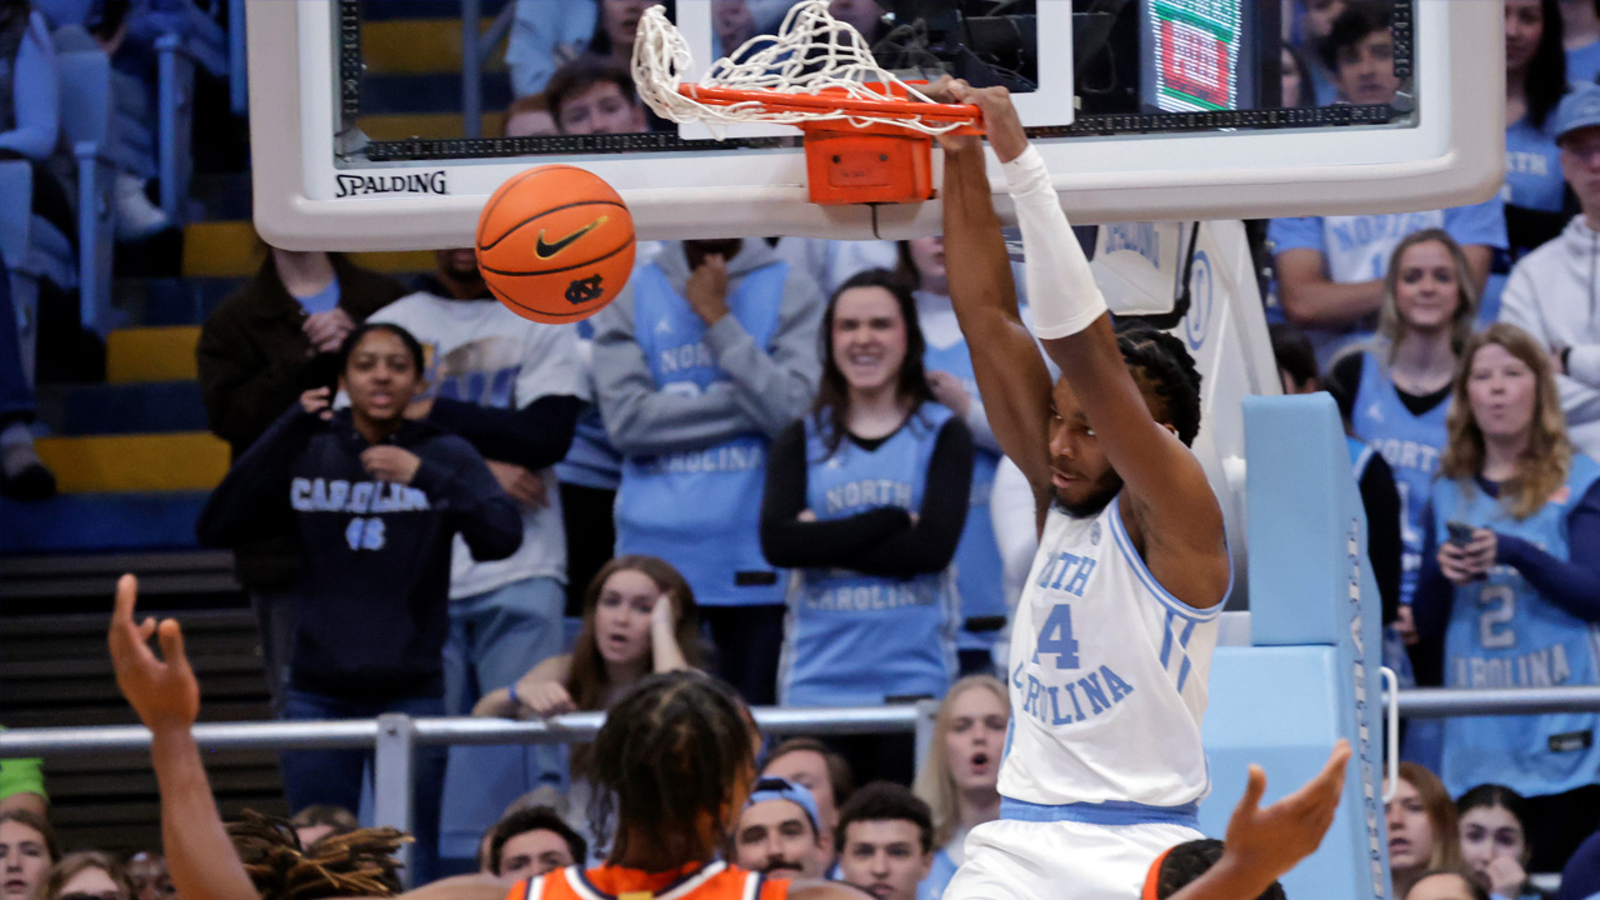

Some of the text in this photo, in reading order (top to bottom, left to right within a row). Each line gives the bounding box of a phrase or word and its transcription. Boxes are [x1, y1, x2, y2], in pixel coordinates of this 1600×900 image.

[335, 170, 448, 198] SPALDING
[826, 479, 912, 513] NORTH
[1032, 604, 1080, 669] 4
[1480, 585, 1516, 649] 2
